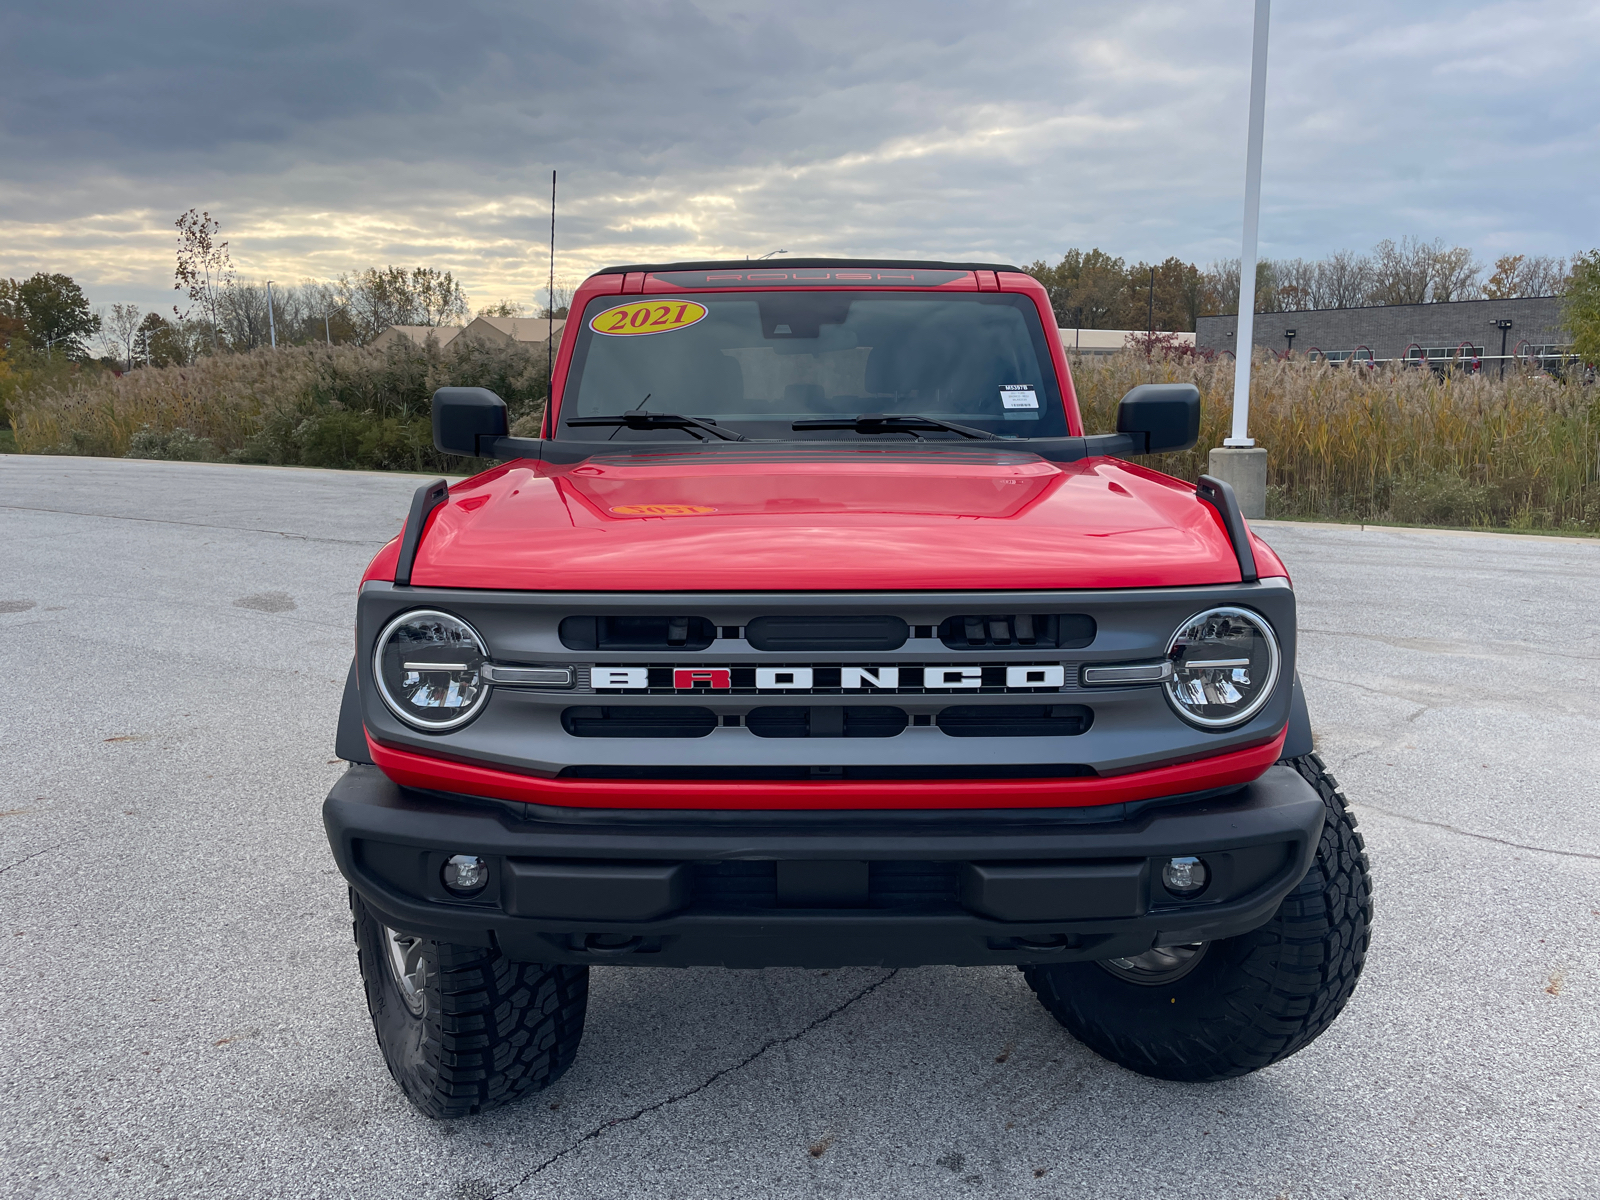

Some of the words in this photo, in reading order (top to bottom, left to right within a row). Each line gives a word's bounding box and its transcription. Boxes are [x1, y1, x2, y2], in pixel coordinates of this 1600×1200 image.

[706, 273, 915, 282] ROUSH
[606, 304, 689, 331] 2021
[590, 665, 1065, 689] BRONCO
